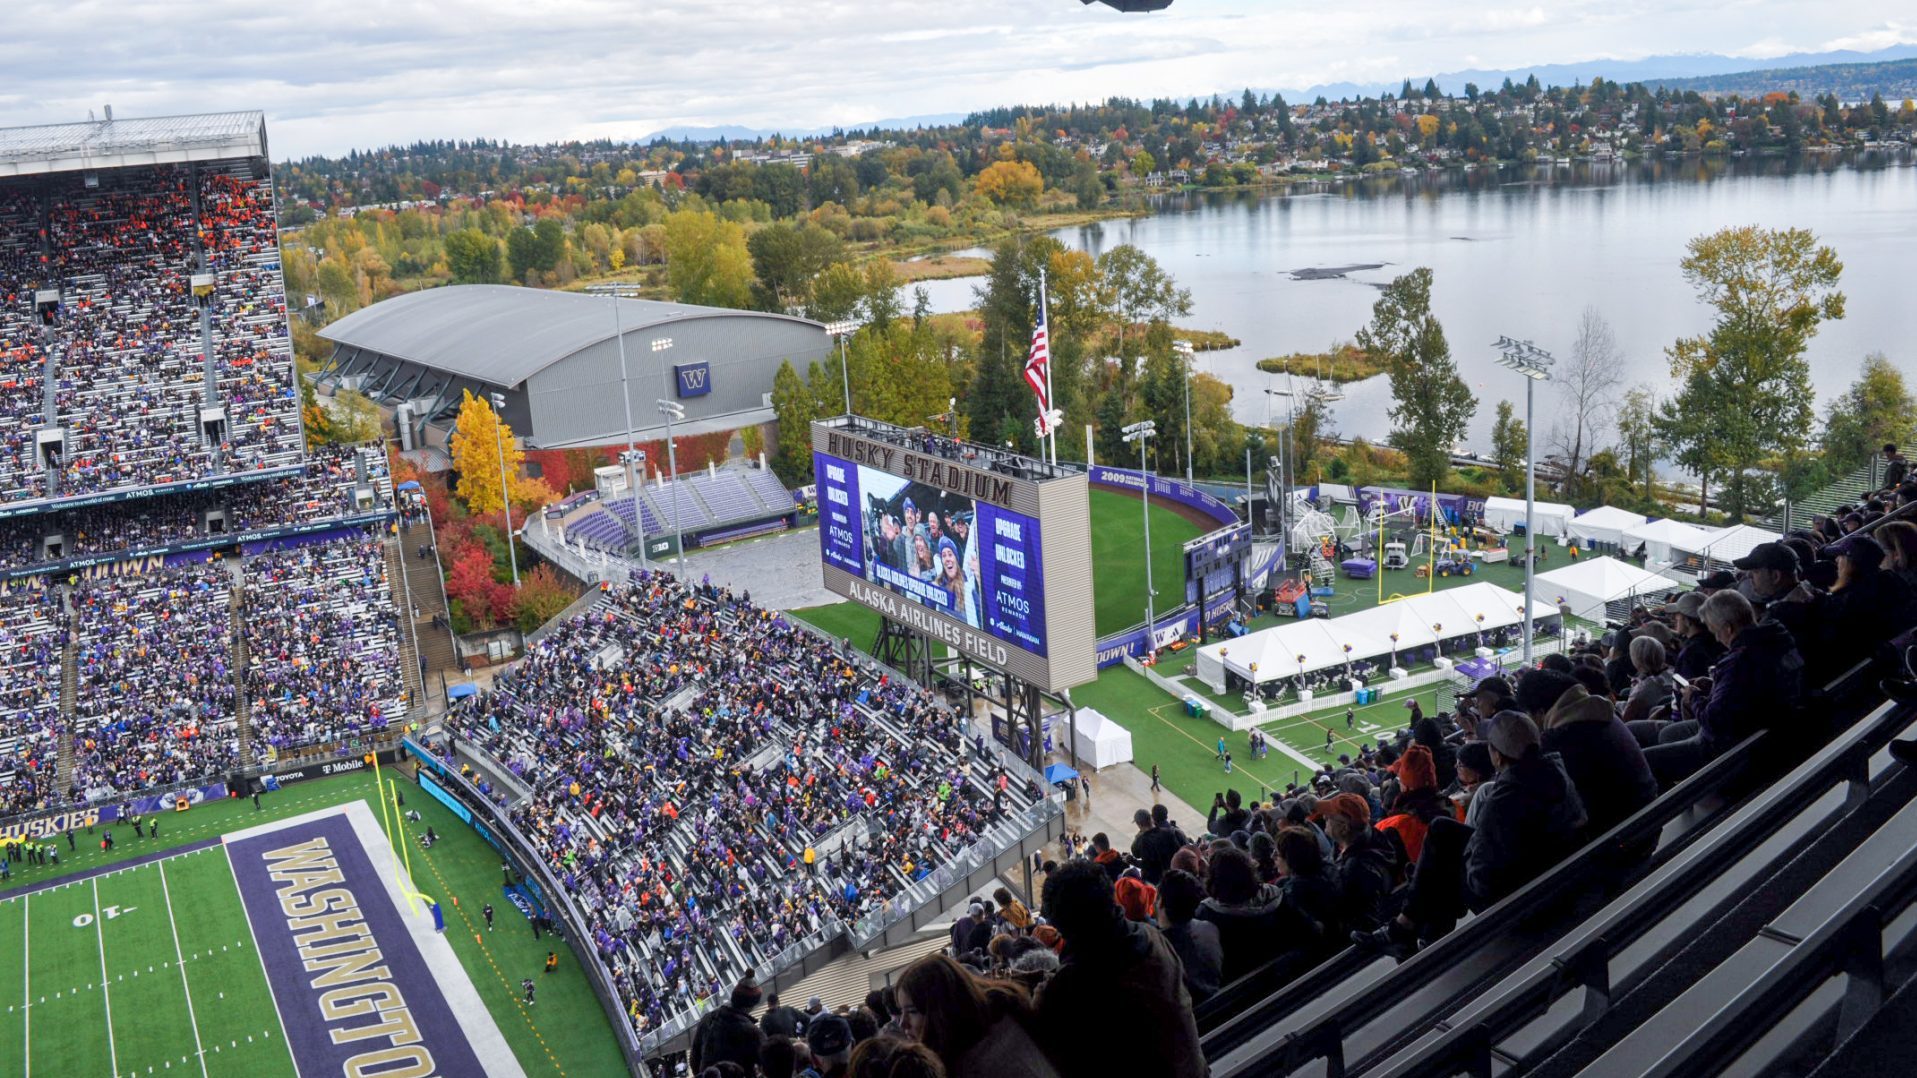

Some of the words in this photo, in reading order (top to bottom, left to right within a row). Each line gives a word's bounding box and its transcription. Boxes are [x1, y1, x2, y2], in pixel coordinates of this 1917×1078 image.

[682, 368, 706, 389] W
[828, 432, 892, 469] HUSKY
[903, 453, 1014, 506] STADIUM
[1101, 471, 1126, 484] 2009
[126, 489, 154, 499] ATMOS
[237, 533, 262, 542] ATMOS
[829, 525, 853, 544] ATMOS
[995, 516, 1021, 542] UPGRADE
[70, 559, 96, 568] ATMOS
[995, 543, 1025, 569] UNLOCKED
[996, 590, 1030, 614] ATMOS
[849, 581, 897, 616] ALASKA
[900, 603, 961, 646] AIRLINES
[965, 632, 1008, 666] FIELD
[1155, 631, 1166, 644] W
[333, 759, 364, 773] Mobile
[275, 771, 304, 783] TOYOTA
[0, 808, 100, 839] HUSKIES
[262, 836, 441, 1078] WASHINGTO
